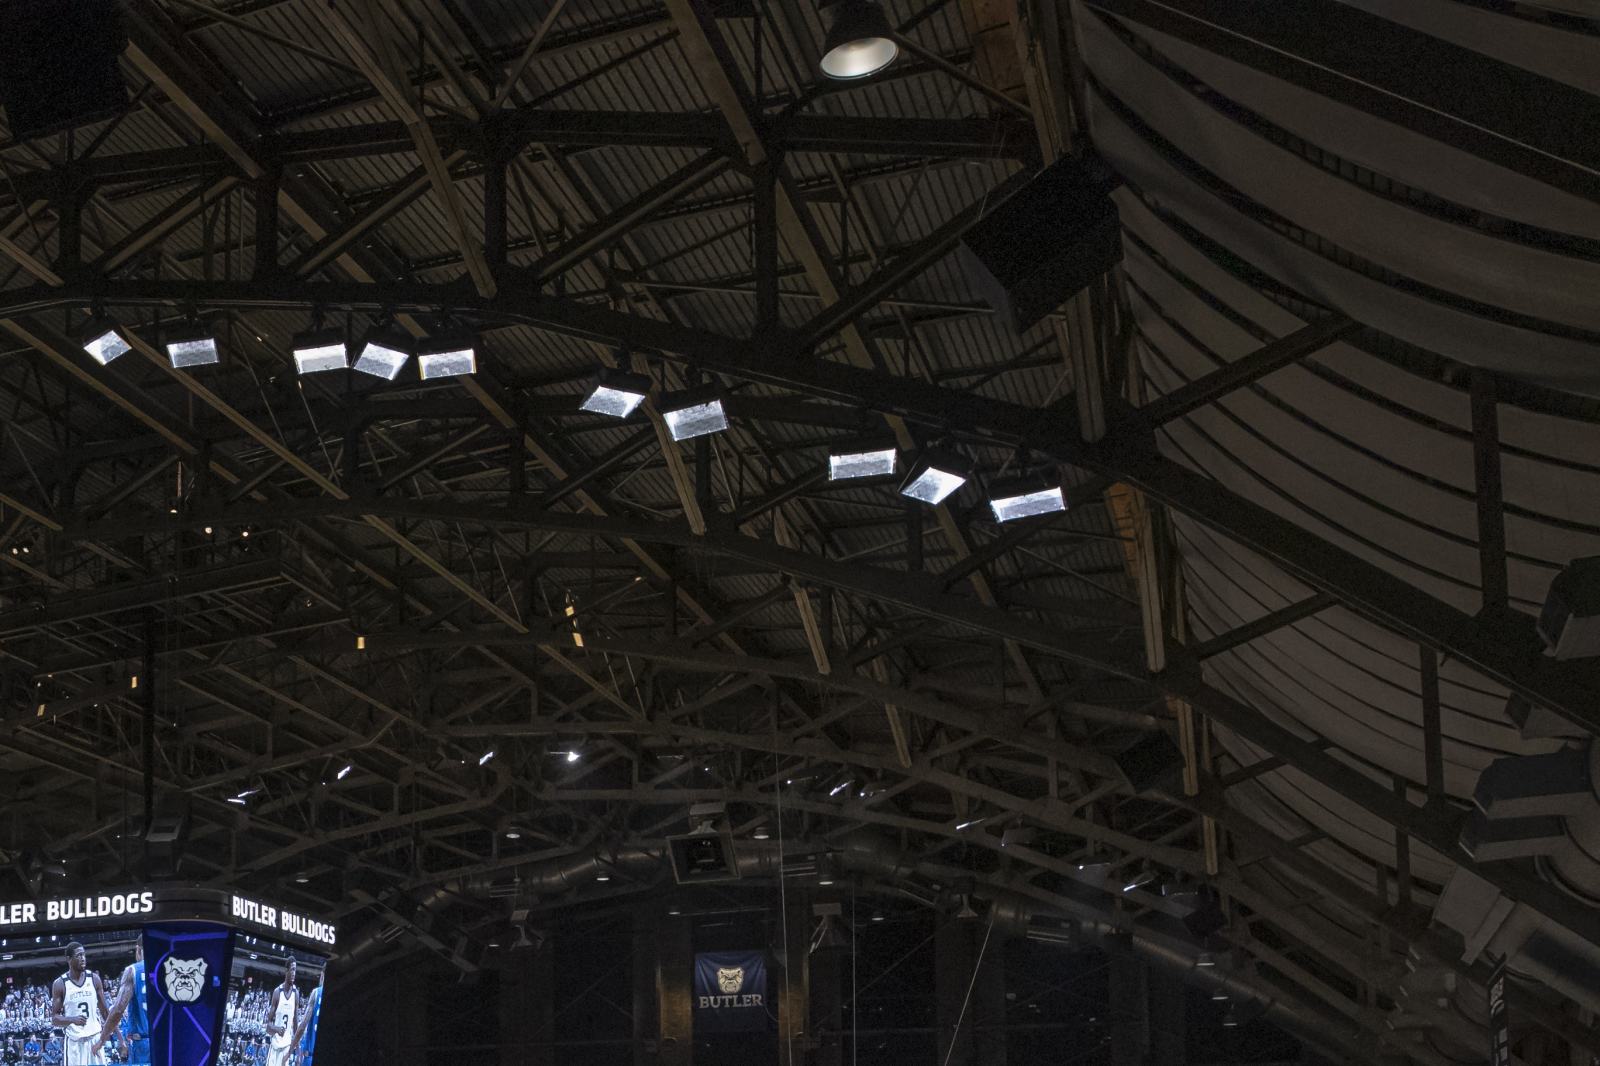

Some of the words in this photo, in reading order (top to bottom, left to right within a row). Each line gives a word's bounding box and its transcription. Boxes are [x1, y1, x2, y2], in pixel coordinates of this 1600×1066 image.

[47, 892, 154, 921] BULLDOGS
[232, 895, 277, 928] BUTLER
[281, 912, 336, 945] BULLDOGS
[78, 1002, 89, 1017] 3
[699, 994, 763, 1008] BUTLER
